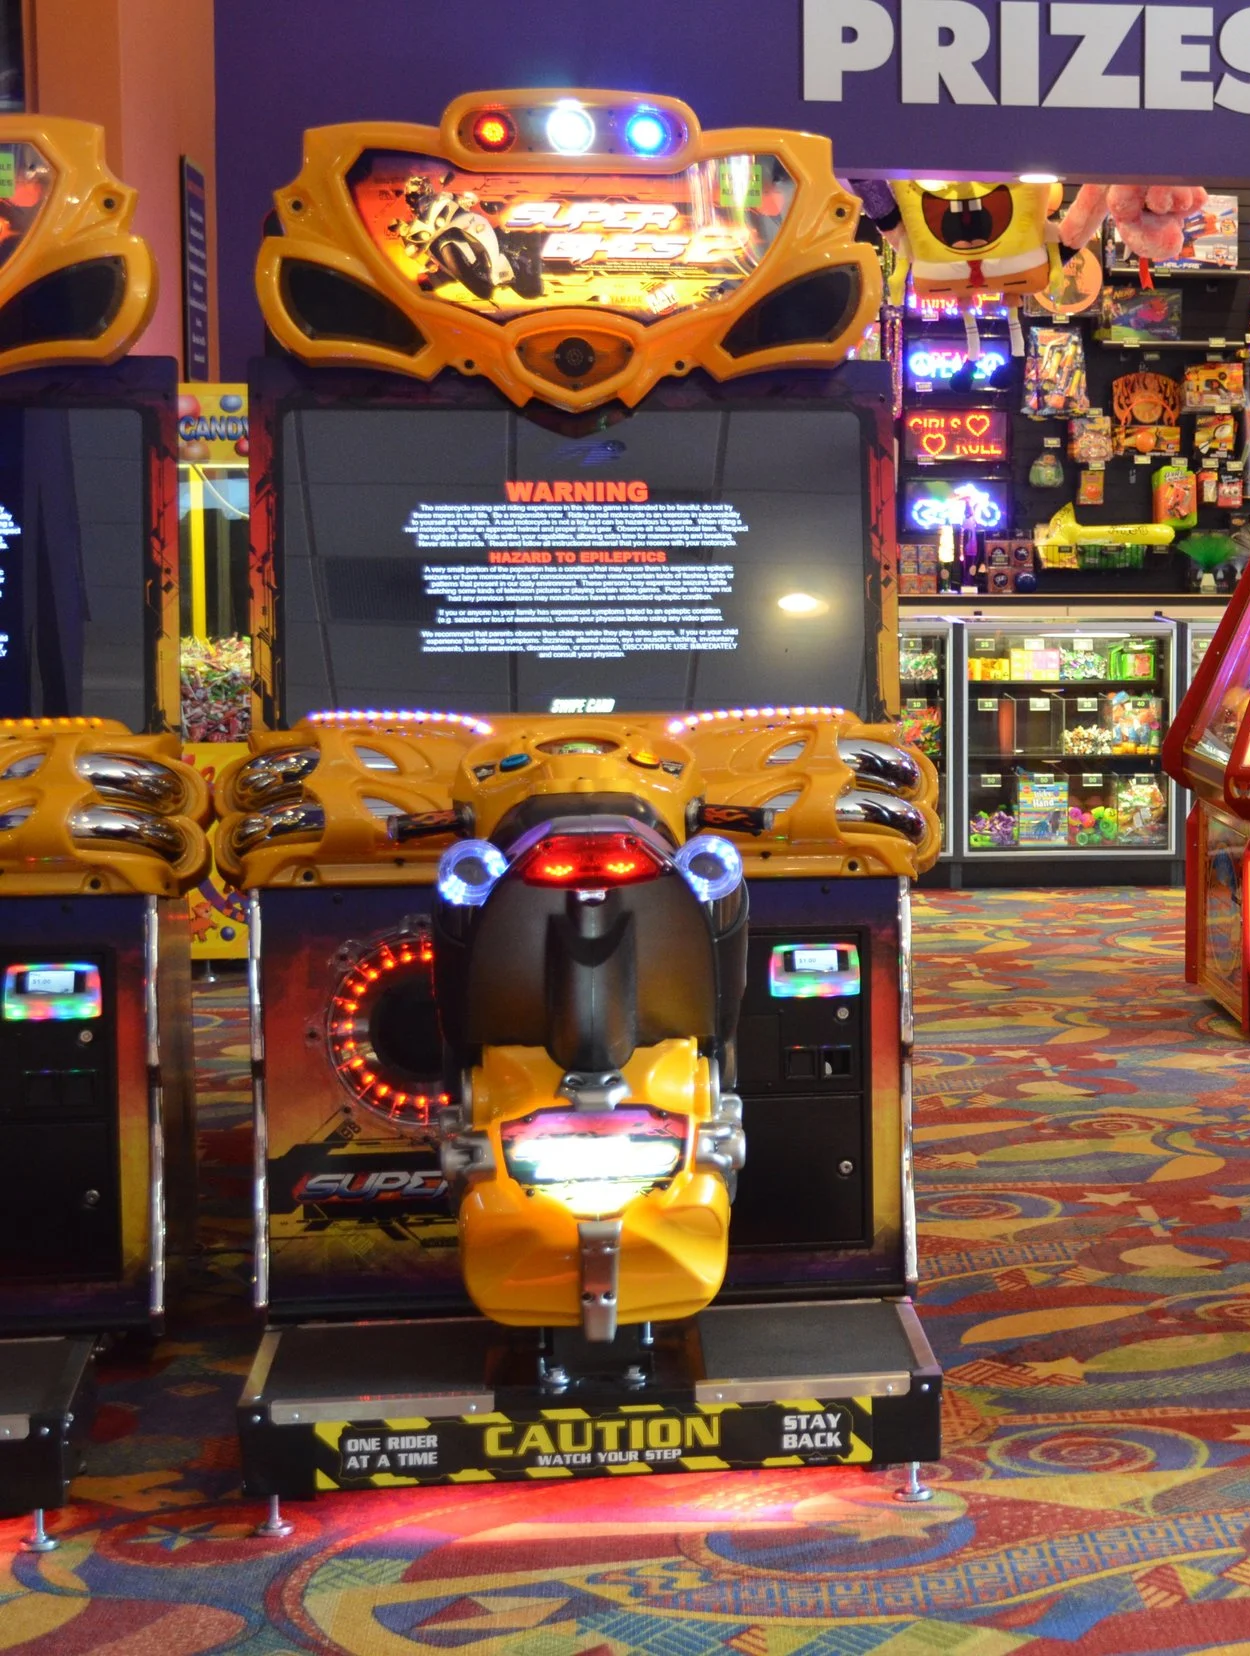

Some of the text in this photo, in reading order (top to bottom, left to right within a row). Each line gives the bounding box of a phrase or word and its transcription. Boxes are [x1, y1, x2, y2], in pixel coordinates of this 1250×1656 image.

[506, 202, 679, 232] SUPER
[505, 481, 648, 502] WARNING
[489, 551, 667, 563] HAZARD TO EPILEPTICS
[1033, 798, 1055, 808] Hand
[783, 1413, 842, 1431] STAY
[346, 1434, 438, 1452] ONE RIDER
[483, 1415, 722, 1458] CAUTION
[783, 1431, 842, 1450] BACK
[346, 1451, 438, 1469] AT A TIME
[537, 1448, 682, 1467] WATCH YOUR STEP
